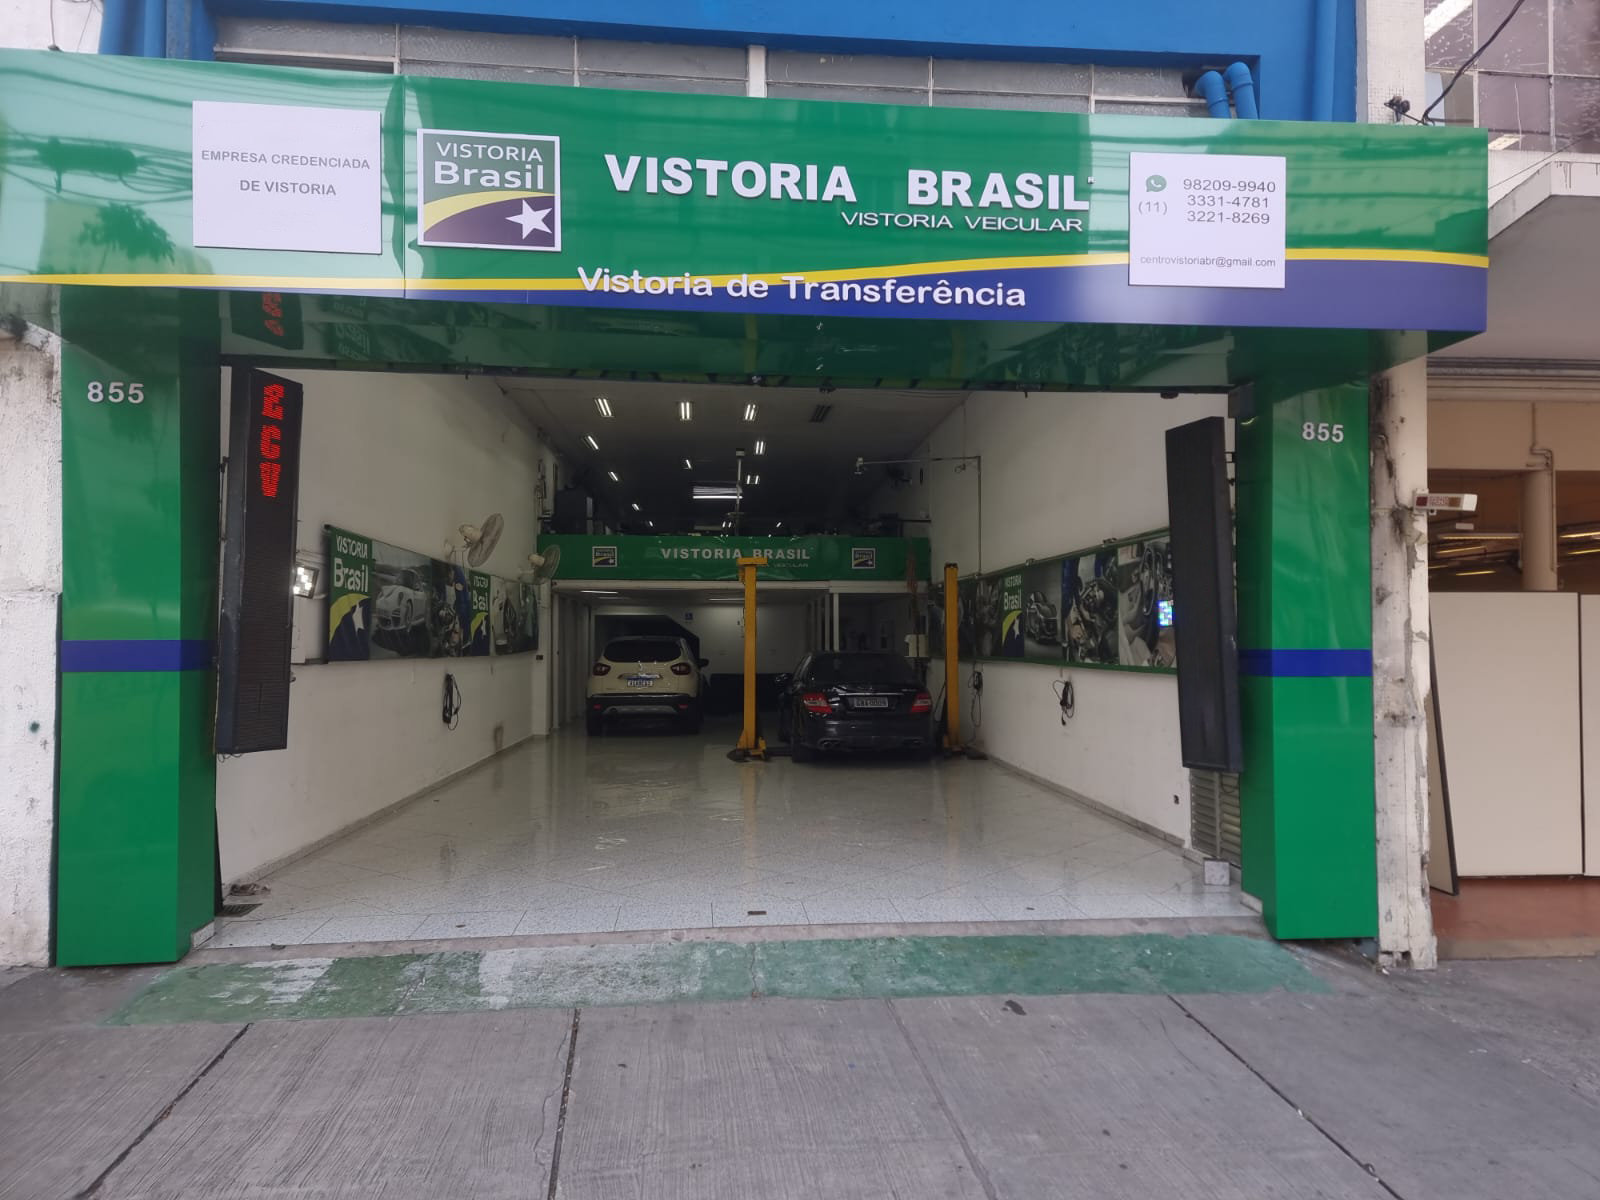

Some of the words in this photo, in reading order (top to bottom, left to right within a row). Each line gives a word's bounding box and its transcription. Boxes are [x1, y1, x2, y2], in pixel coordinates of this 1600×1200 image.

[201, 149, 267, 164] EMPRESA
[271, 153, 370, 169] CREDENCIADA
[436, 141, 543, 162] VISTORIA
[434, 160, 544, 190] Brasil
[604, 153, 856, 202] VISTORIA
[907, 169, 1090, 211] BRASIL
[1183, 178, 1276, 193] 98209-9940
[239, 179, 261, 192] DE
[264, 181, 337, 196] VISTORIA
[1138, 201, 1168, 216] (11)
[1187, 194, 1269, 208] 3331-4781
[841, 211, 953, 229] VISTORIA
[965, 215, 1083, 232] VEICULAR
[1187, 210, 1270, 224] 3221-8269
[1140, 255, 1276, 268] centrovistoriabr@gmail.com
[577, 266, 713, 297] Vistoria
[726, 273, 769, 298] de
[781, 275, 1026, 306] Transferência
[87, 381, 145, 404] 855
[1302, 421, 1344, 443] 855
[336, 535, 368, 559] VISTORIA
[660, 548, 742, 559] VISTORIA
[752, 548, 810, 560] BRASIL
[334, 557, 369, 593] Brasil
[1003, 588, 1022, 611] Brasil
